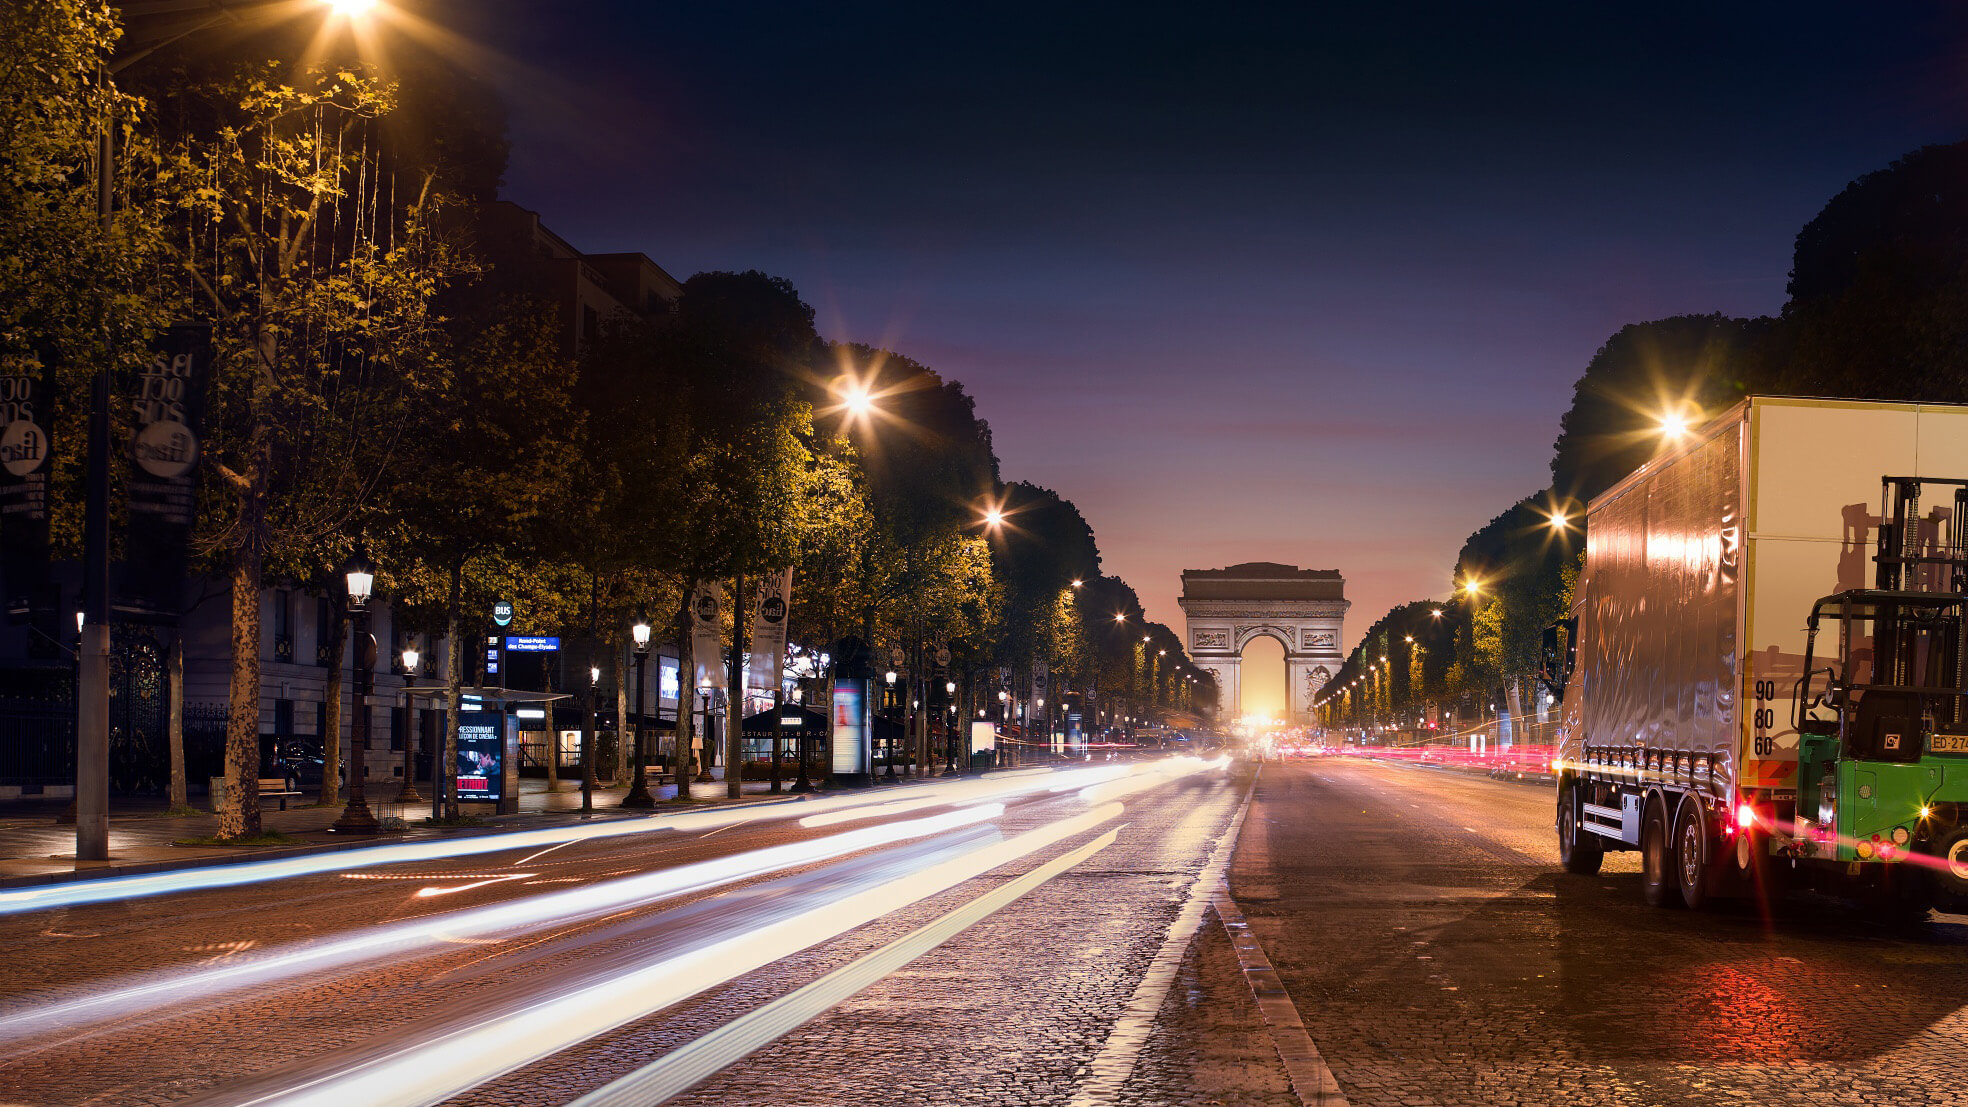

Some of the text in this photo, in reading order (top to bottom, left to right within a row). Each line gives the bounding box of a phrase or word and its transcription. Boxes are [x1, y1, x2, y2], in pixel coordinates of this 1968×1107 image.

[495, 606, 511, 615] BUS
[1755, 680, 1775, 701] 90
[1755, 708, 1774, 729] 80
[1754, 736, 1773, 756] 60
